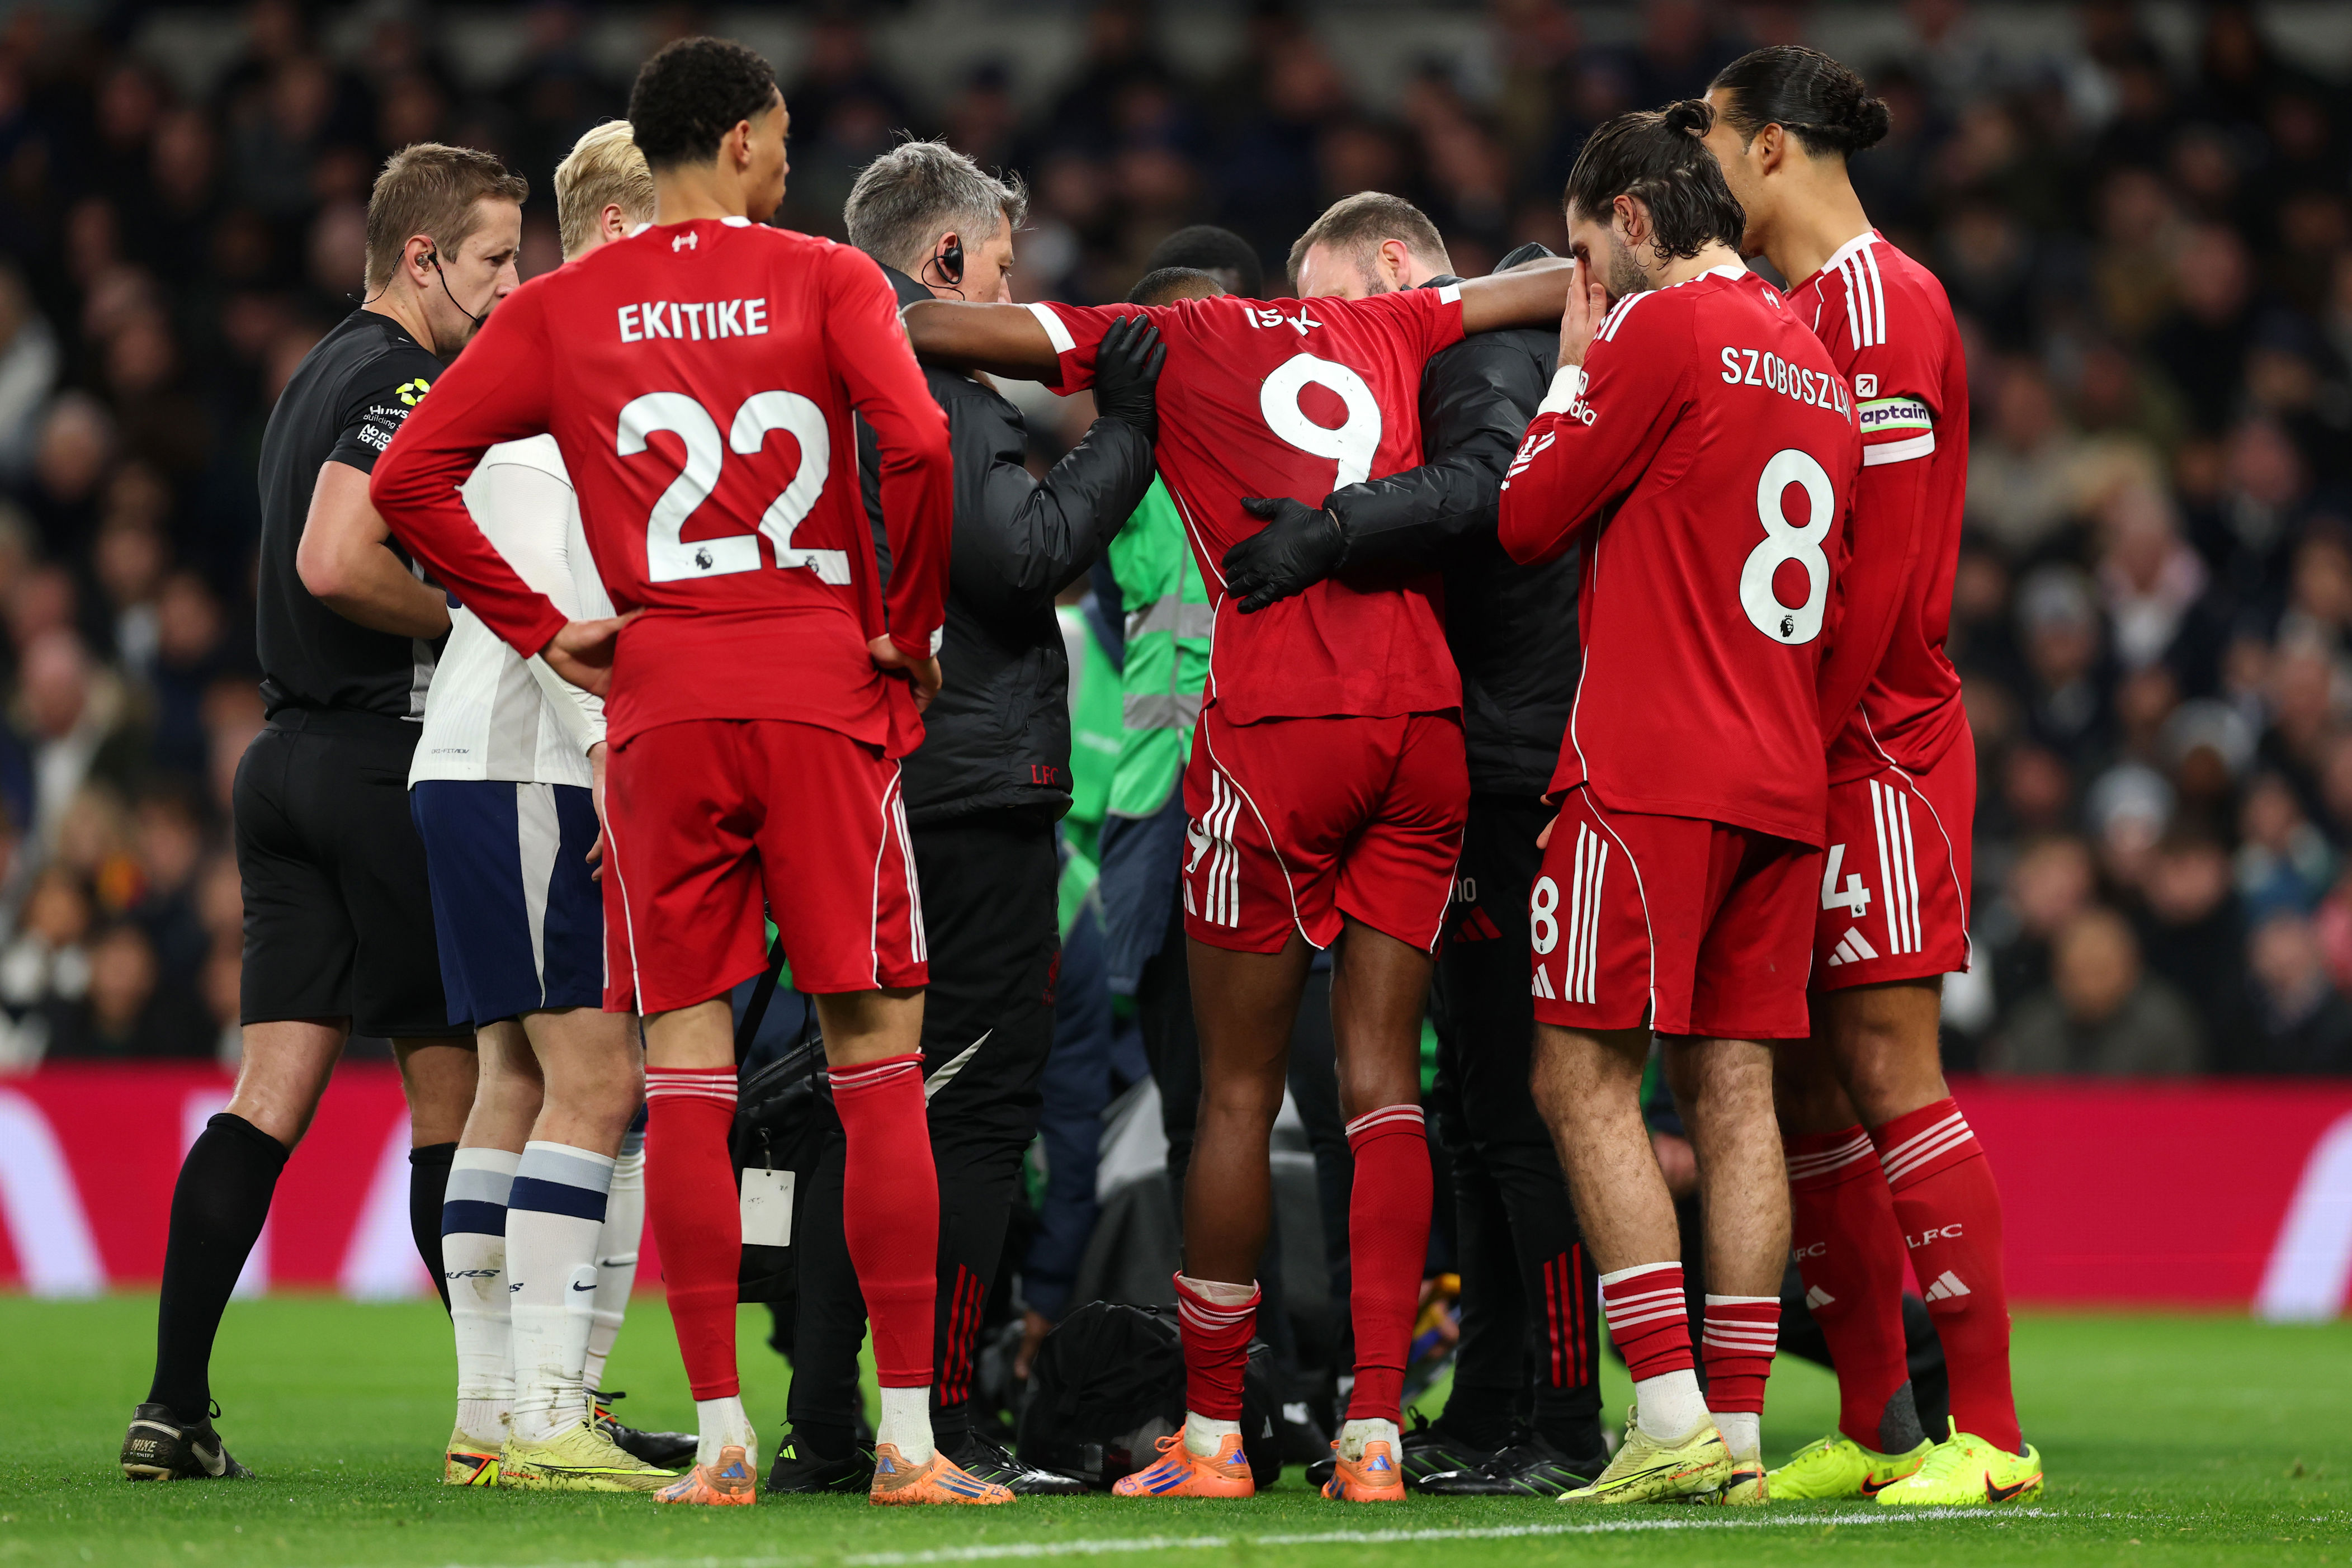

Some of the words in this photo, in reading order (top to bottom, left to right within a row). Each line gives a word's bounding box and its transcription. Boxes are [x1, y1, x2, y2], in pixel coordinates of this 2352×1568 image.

[617, 297, 769, 343] EKITIKE
[1244, 305, 1323, 336] ISK
[363, 414, 396, 429] Building
[1259, 352, 1383, 492] 9
[1570, 399, 1598, 427] dia
[1858, 403, 1928, 424] aptain
[616, 390, 852, 585] 22
[1739, 448, 1835, 645] 8
[1031, 764, 1059, 786] LFC
[1821, 844, 1871, 918] 4
[1531, 876, 1560, 955] 8
[1906, 1223, 1963, 1249] LFC
[1793, 1241, 1826, 1262] FC
[130, 1439, 158, 1452] NIKE
